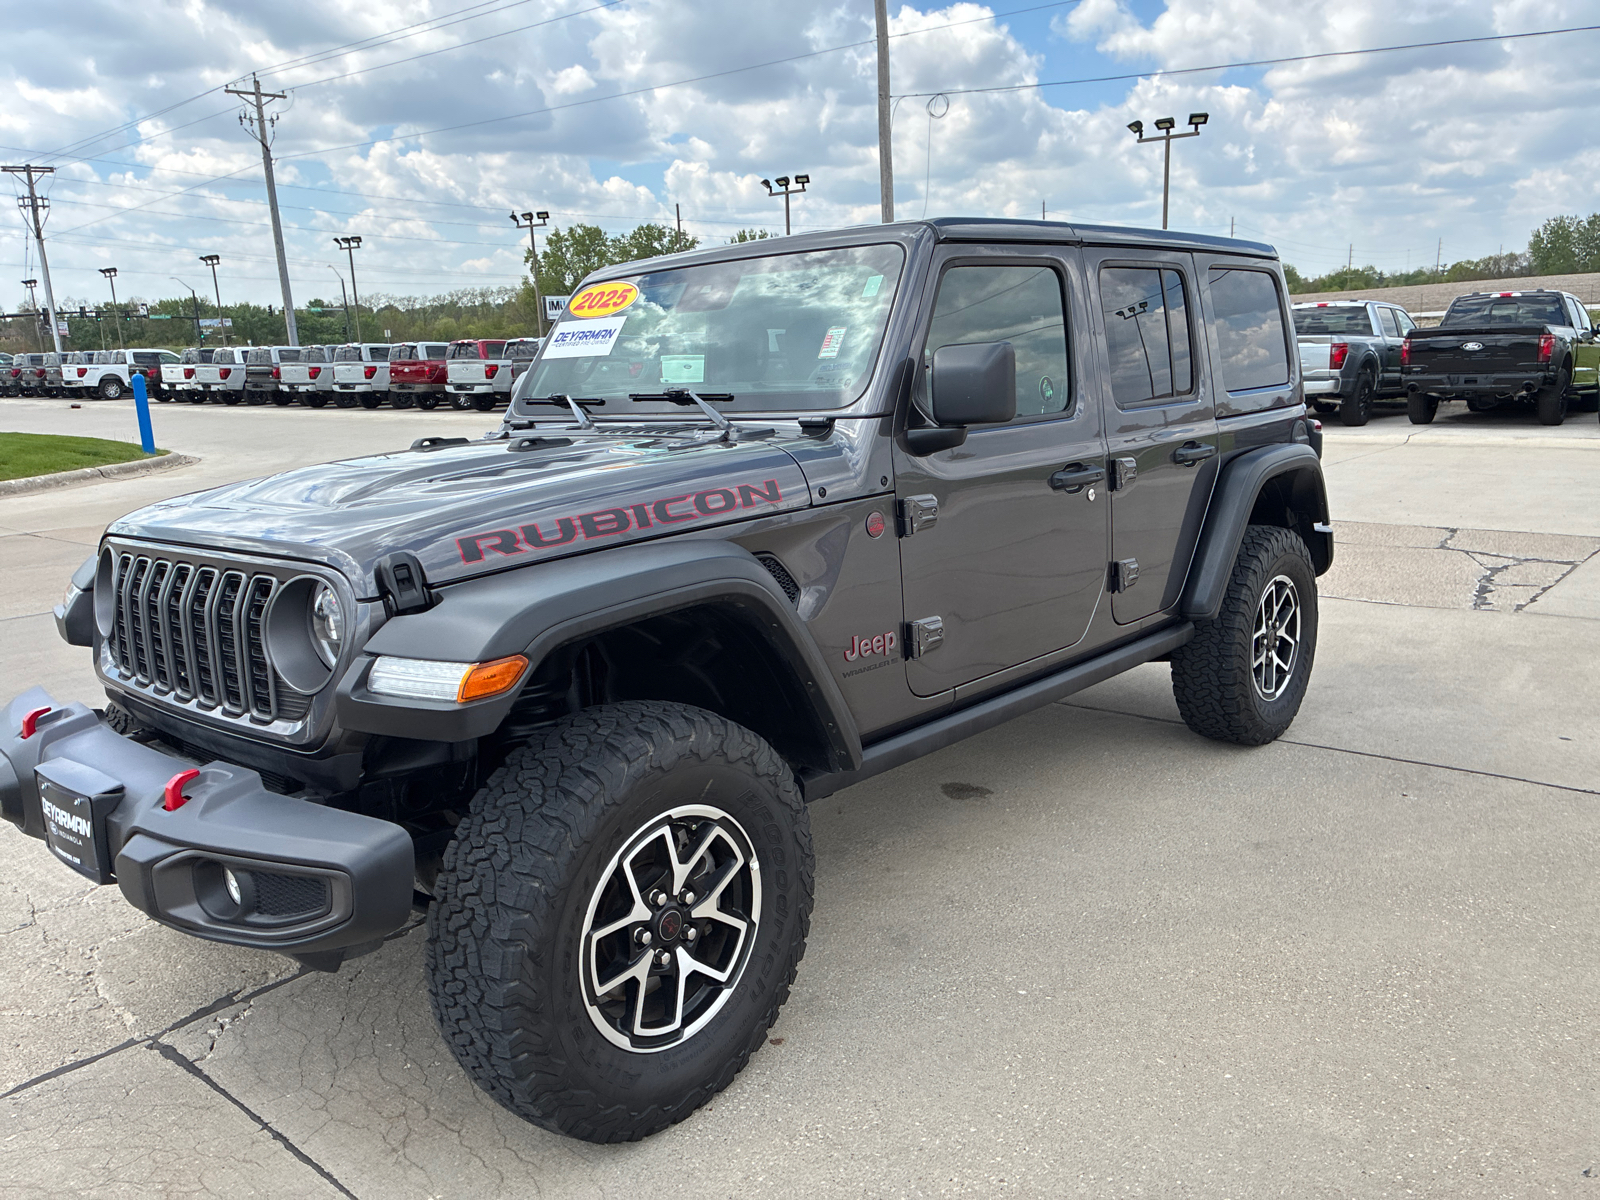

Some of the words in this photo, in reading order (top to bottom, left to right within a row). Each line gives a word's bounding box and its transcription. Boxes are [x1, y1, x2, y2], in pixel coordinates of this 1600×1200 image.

[573, 288, 633, 311] 2025
[554, 328, 617, 343] DEYARMAN
[455, 479, 783, 565] RUBICON
[844, 631, 897, 662] Jeep
[842, 660, 890, 679] WRANGLER
[41, 797, 91, 838] DEYARMAN
[737, 788, 789, 1004] BFGoodrich
